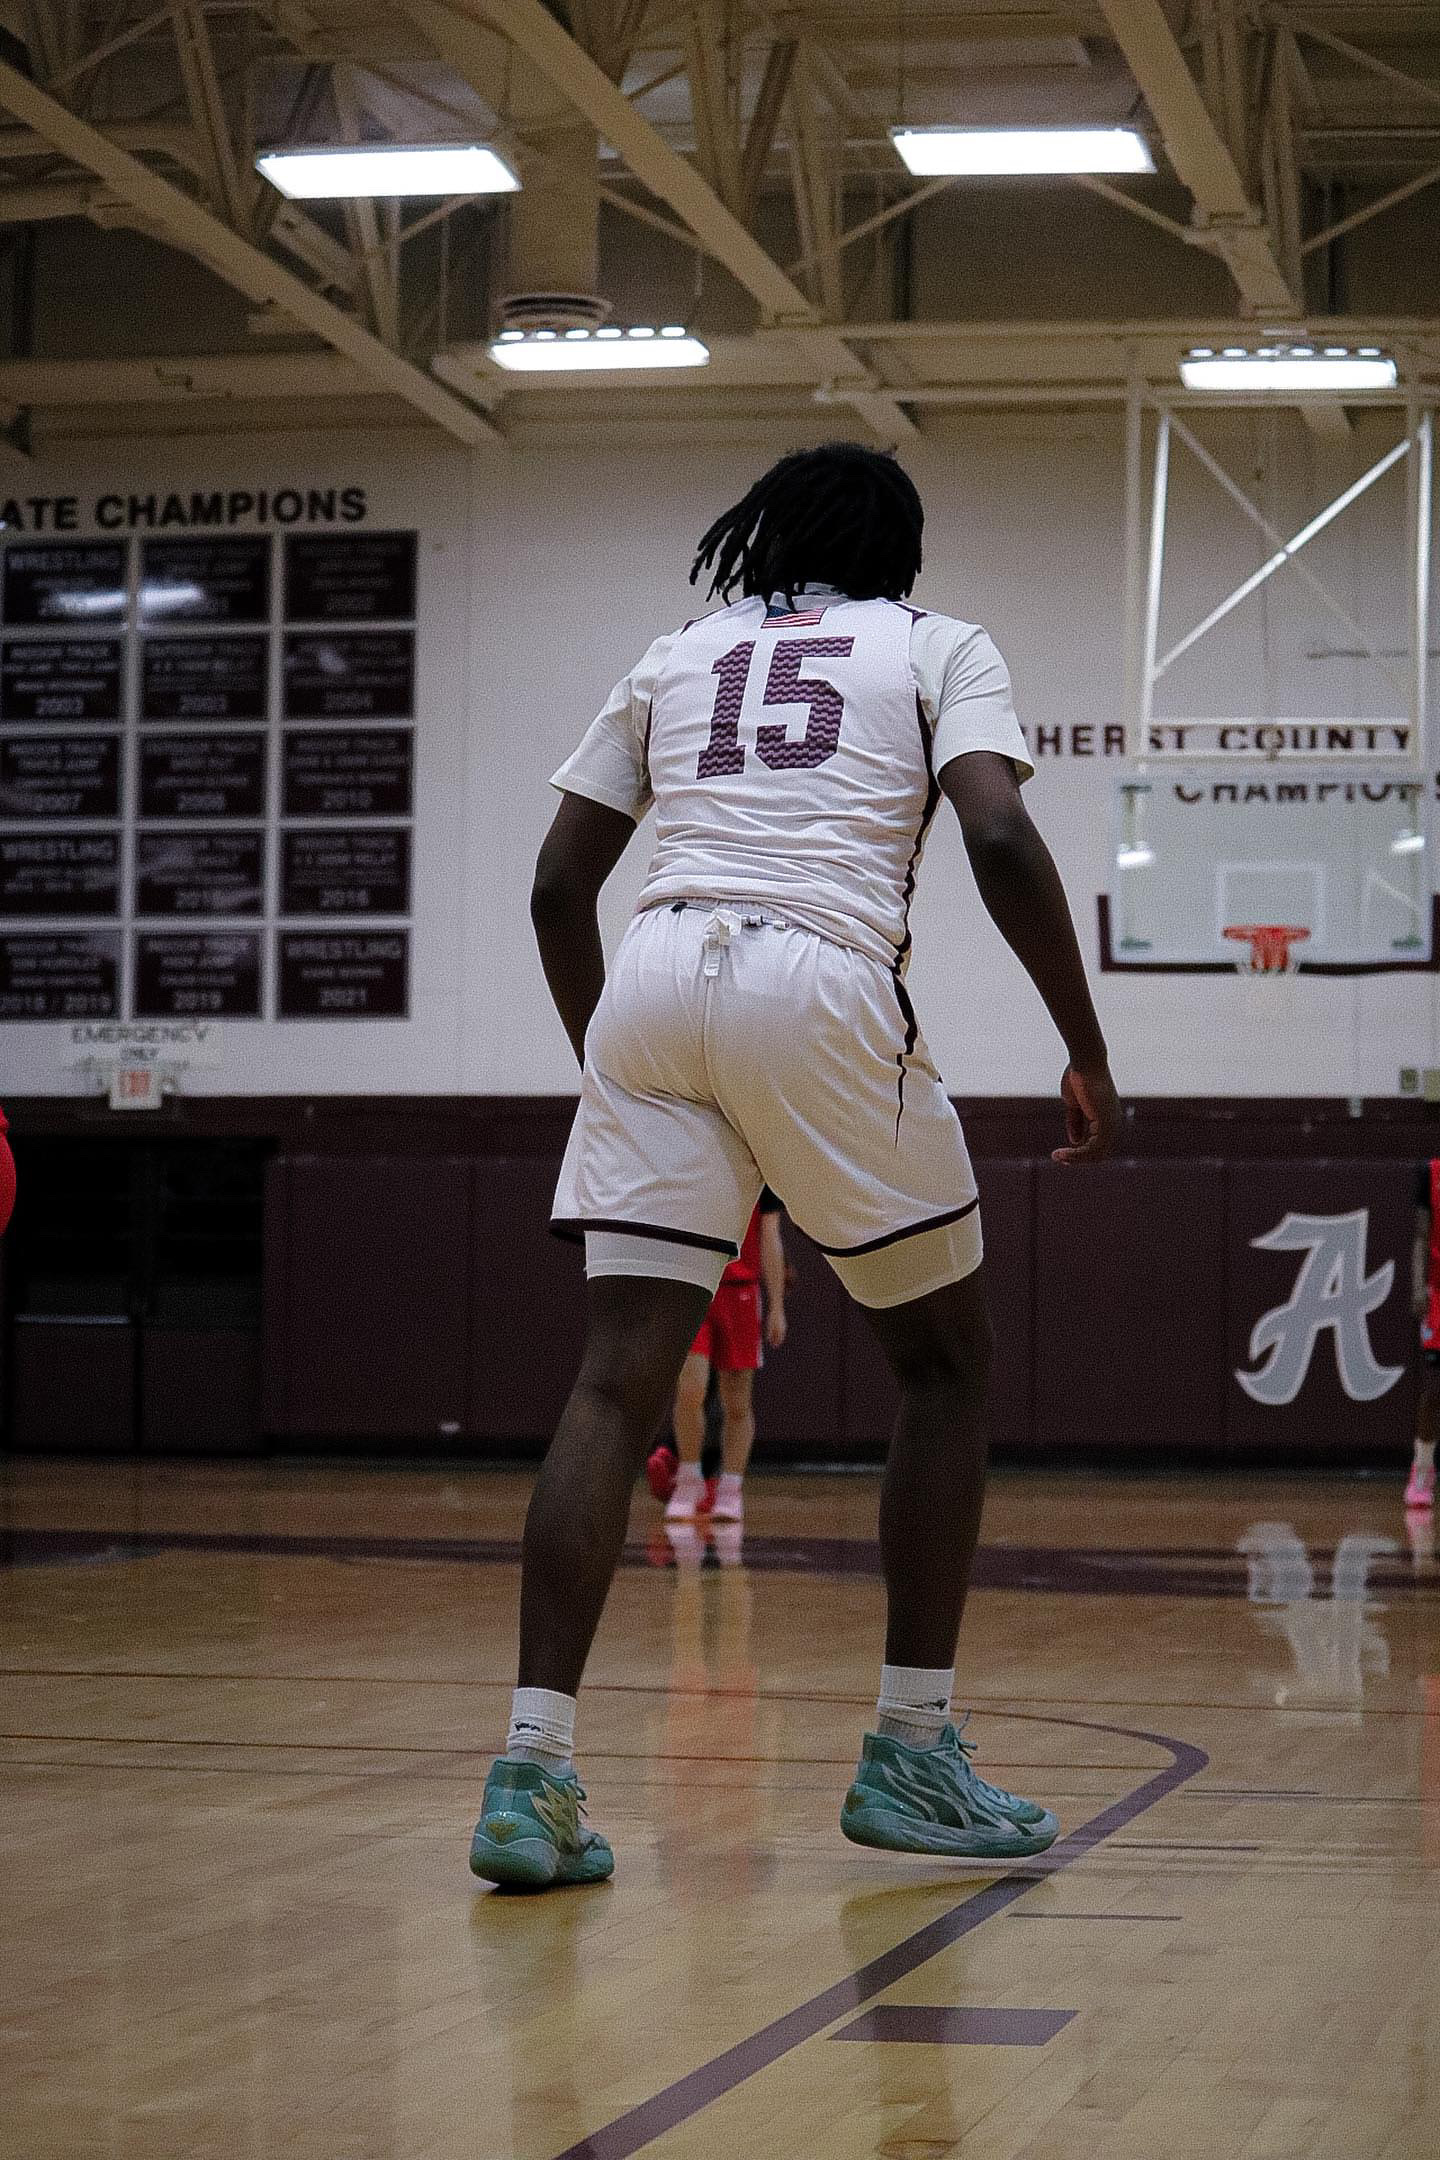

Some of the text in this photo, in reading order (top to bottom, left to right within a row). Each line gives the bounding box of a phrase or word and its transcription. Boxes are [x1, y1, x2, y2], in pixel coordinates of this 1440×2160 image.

[0, 487, 367, 531] ATE CHAMPIONS
[9, 552, 119, 570] WRESTLING
[697, 636, 855, 780] 15
[1219, 726, 1410, 750] COUNTY
[3, 841, 114, 860] WRESTLING
[286, 940, 402, 959] WRESTLING
[320, 988, 368, 1007] 2021
[71, 1025, 208, 1043] EMERGENCY
[1235, 1207, 1404, 1405] A
